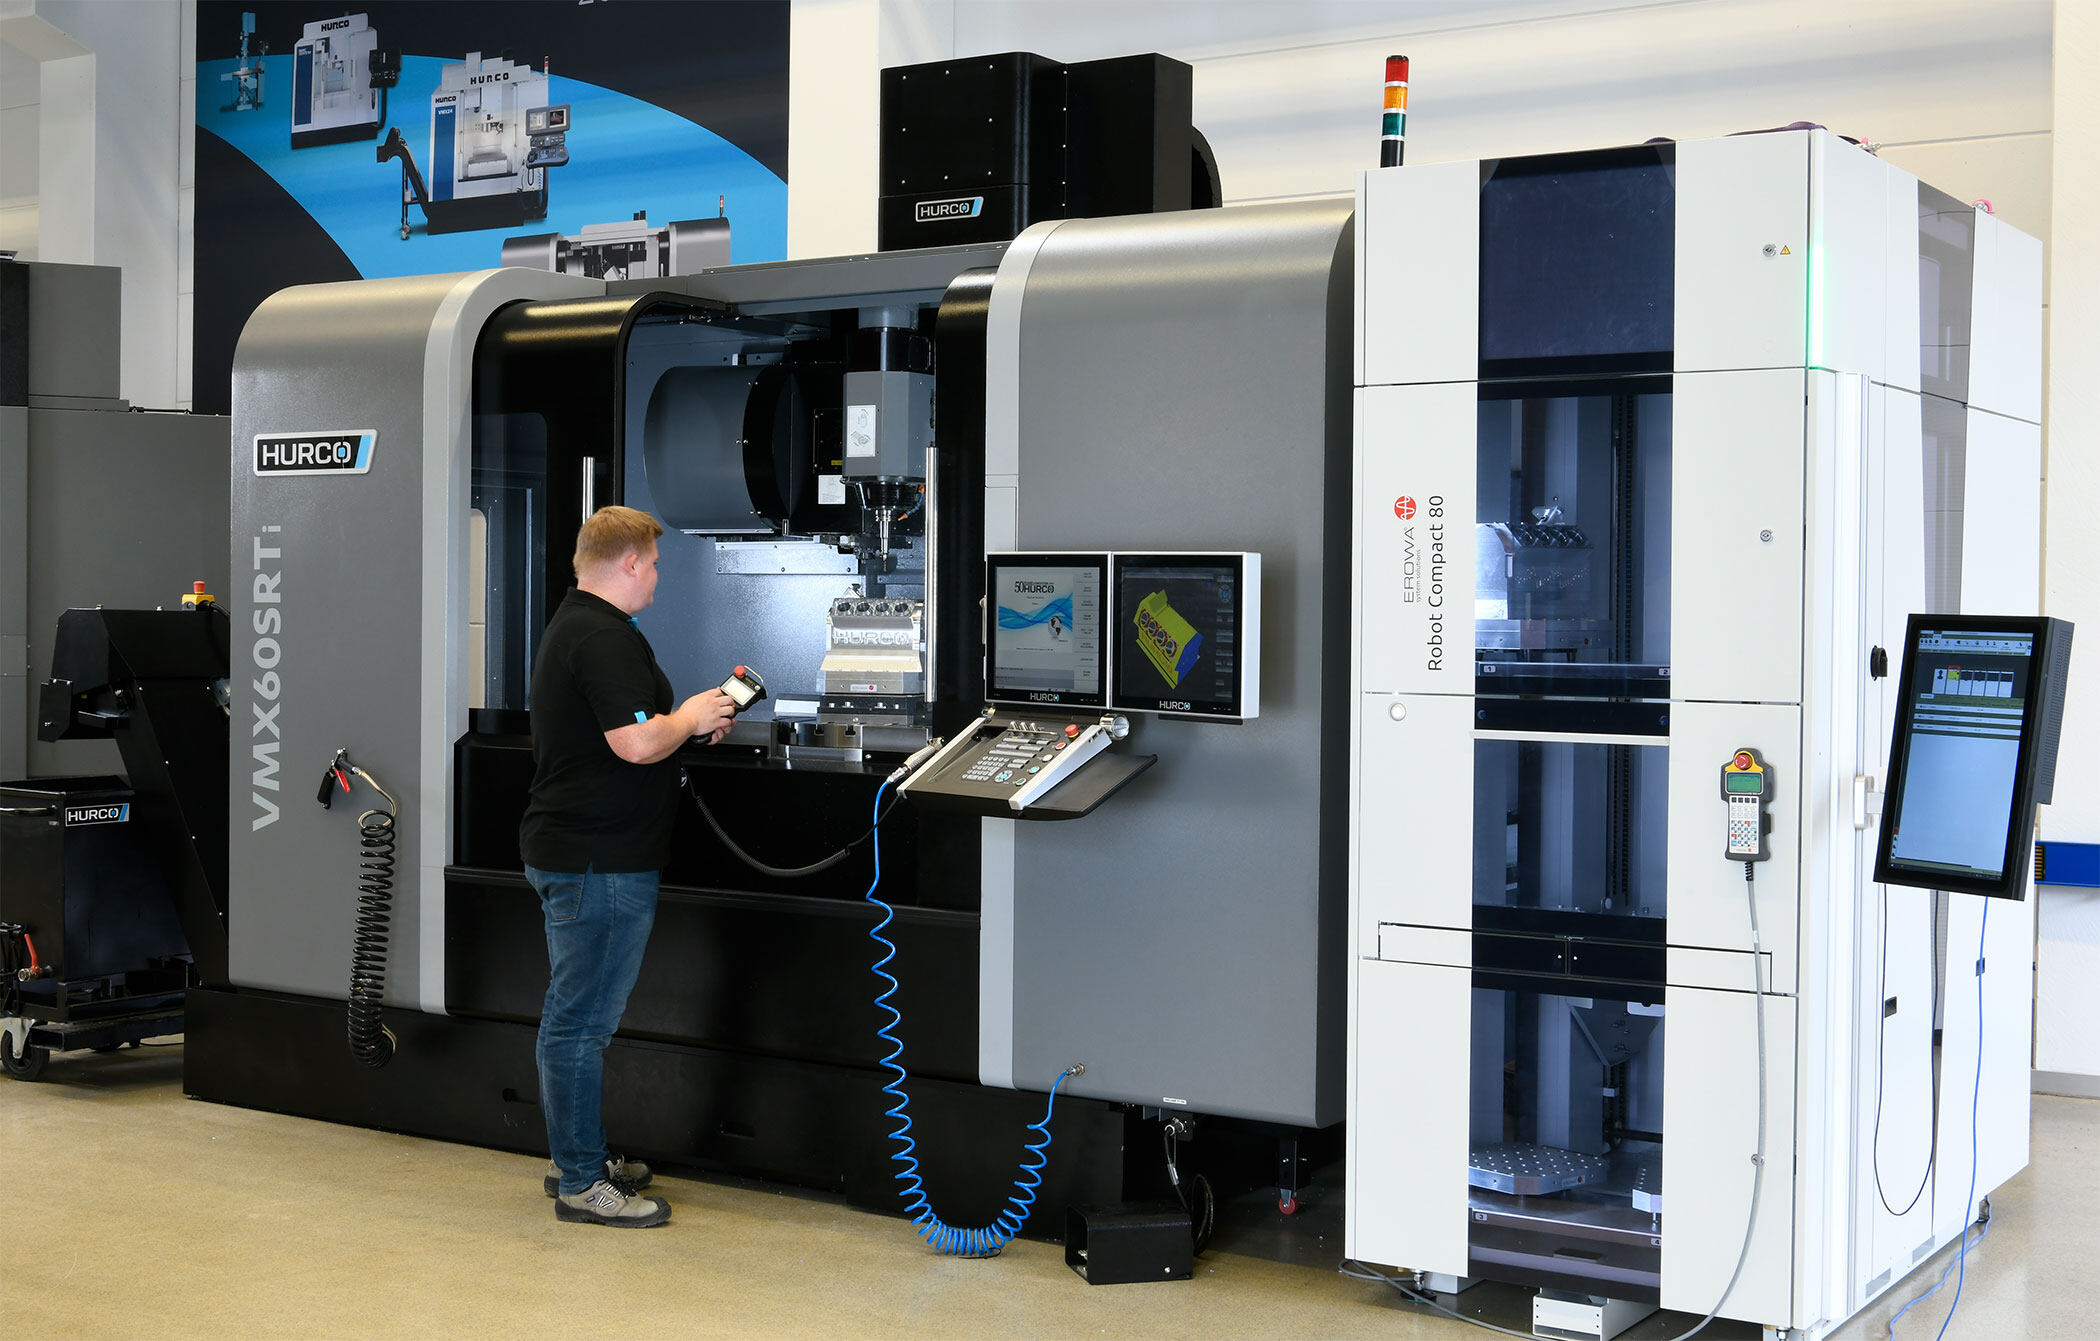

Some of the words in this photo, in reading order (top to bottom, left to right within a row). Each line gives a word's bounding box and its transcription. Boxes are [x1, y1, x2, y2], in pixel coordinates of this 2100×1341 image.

[470, 72, 509, 85] HURCO
[435, 95, 456, 103] HURCO
[921, 203, 969, 217] HURCO
[262, 441, 352, 466] HURCO
[1429, 495, 1444, 518] 80
[1403, 527, 1415, 603] EROWA
[1428, 523, 1446, 608] Compact
[1427, 614, 1443, 671] Robot
[1030, 693, 1060, 702] HURCO
[1159, 700, 1191, 711] HURCO
[68, 807, 119, 822] HURCO
